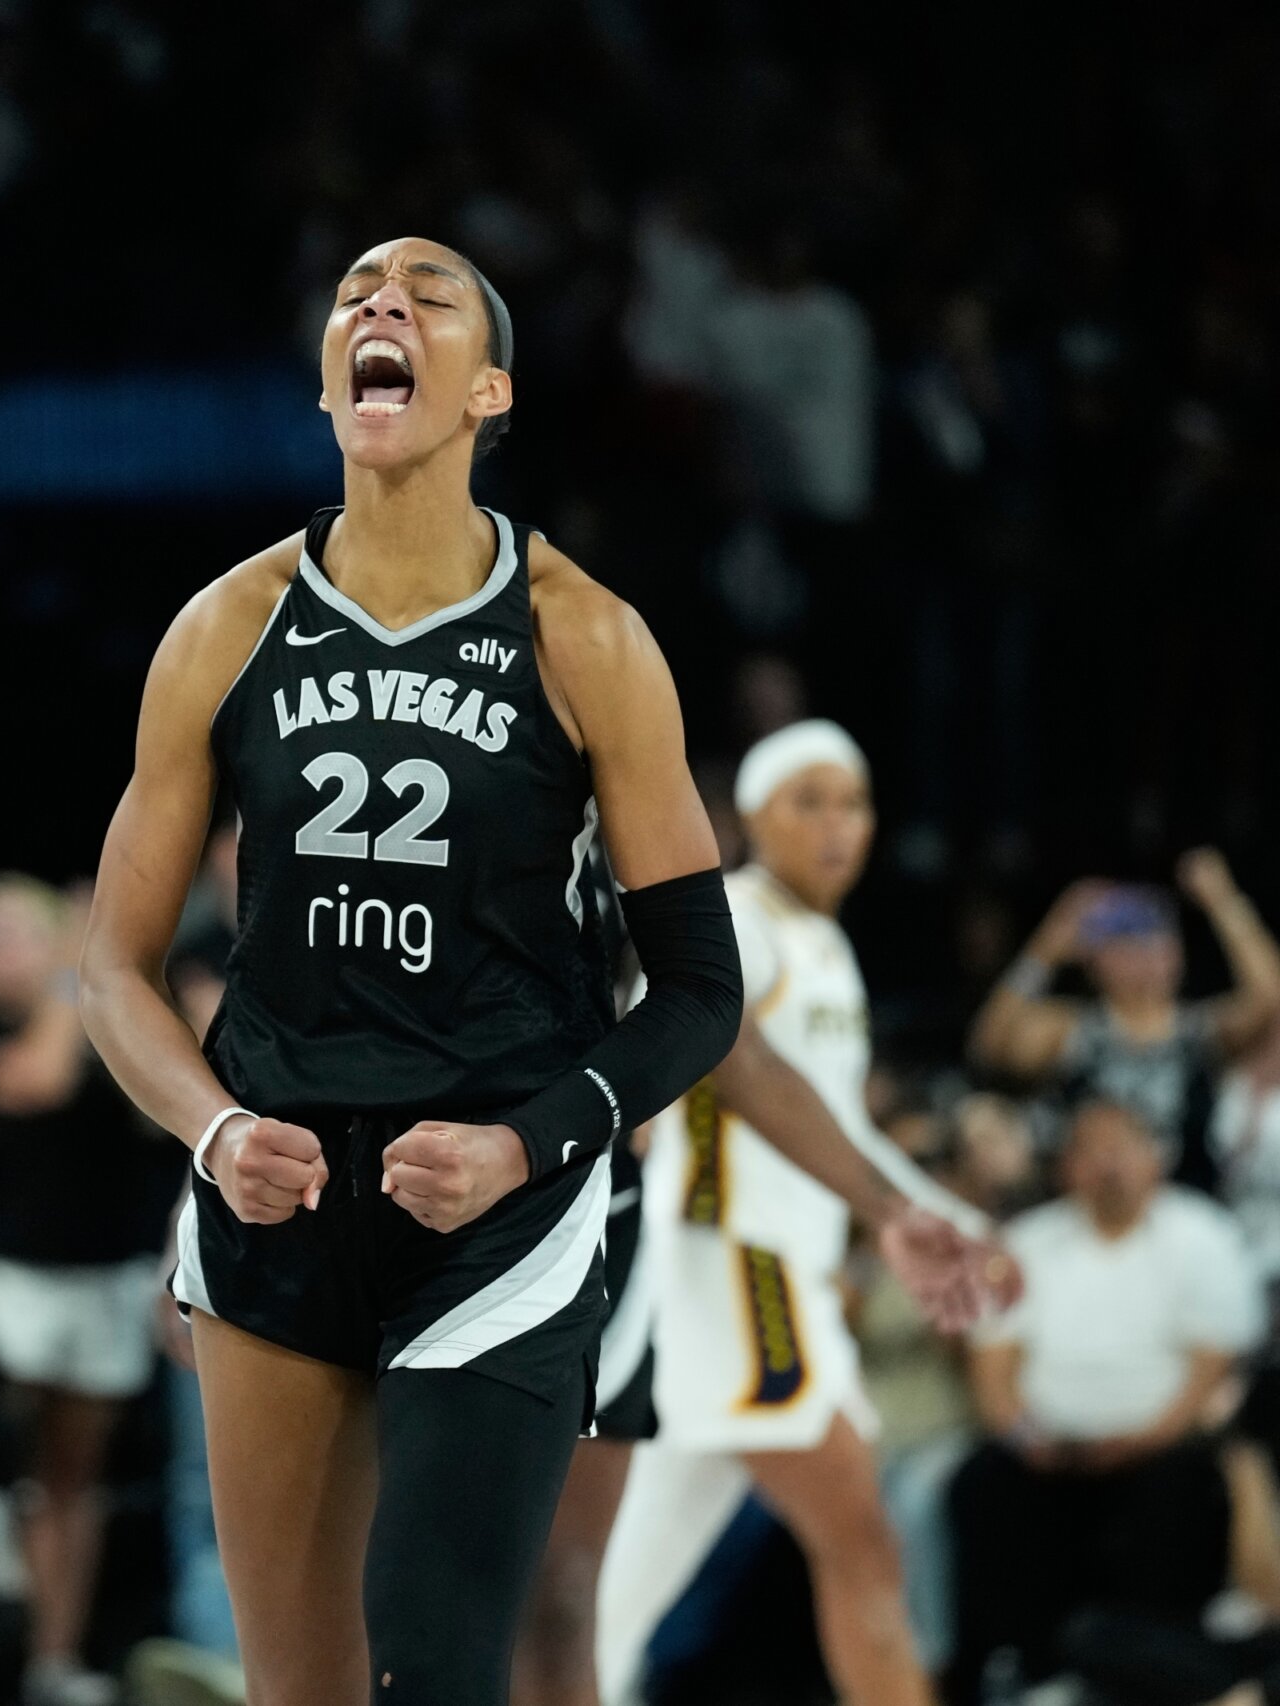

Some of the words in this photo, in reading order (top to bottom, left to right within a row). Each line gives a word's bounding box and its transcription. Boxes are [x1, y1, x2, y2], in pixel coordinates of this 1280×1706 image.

[458, 637, 518, 674] ally
[272, 670, 360, 740] LAS
[366, 669, 518, 753] VEGAS
[295, 751, 450, 868] 22
[308, 883, 433, 974] ring
[583, 1067, 618, 1108] ROMANS
